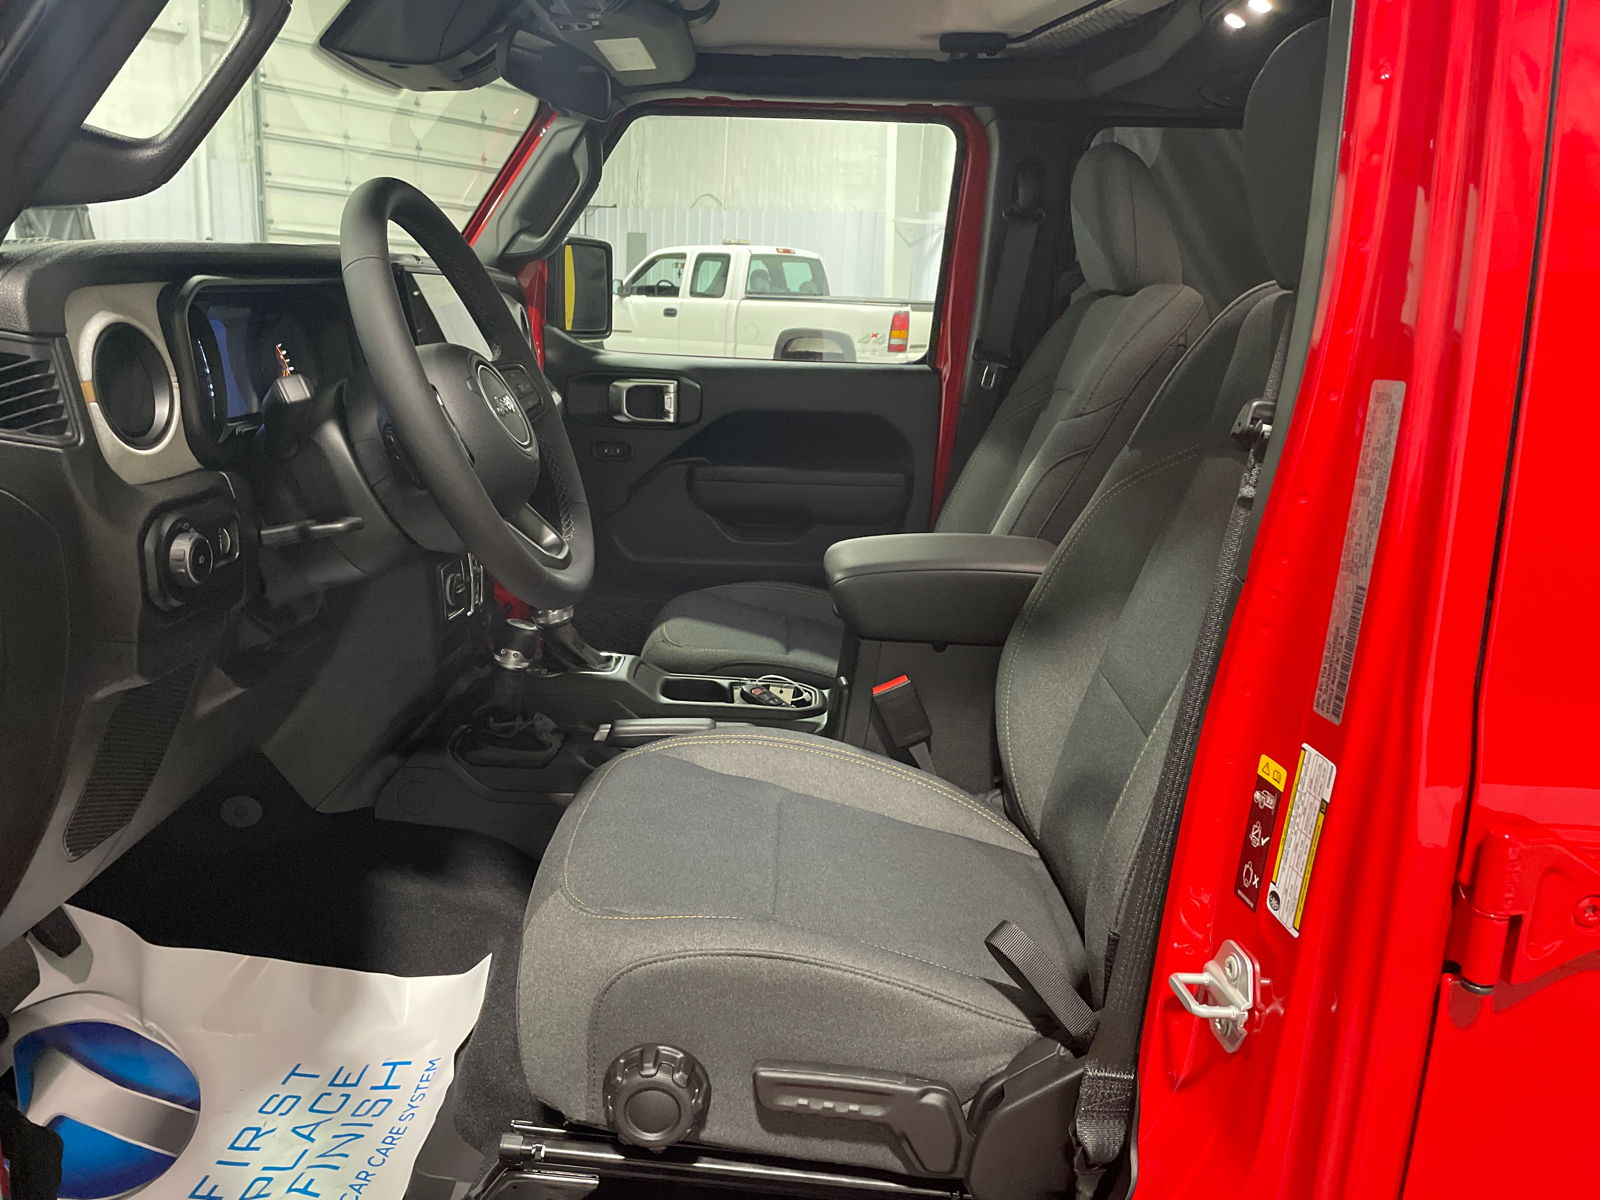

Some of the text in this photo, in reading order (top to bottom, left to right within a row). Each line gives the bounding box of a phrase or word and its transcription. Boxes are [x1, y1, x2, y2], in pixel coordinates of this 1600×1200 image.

[187, 1063, 321, 1200] FIRST
[238, 1064, 371, 1200] PLACE
[285, 1060, 413, 1198] FINISH
[367, 1126, 408, 1168] CARE
[398, 1057, 441, 1121] SYSTEM
